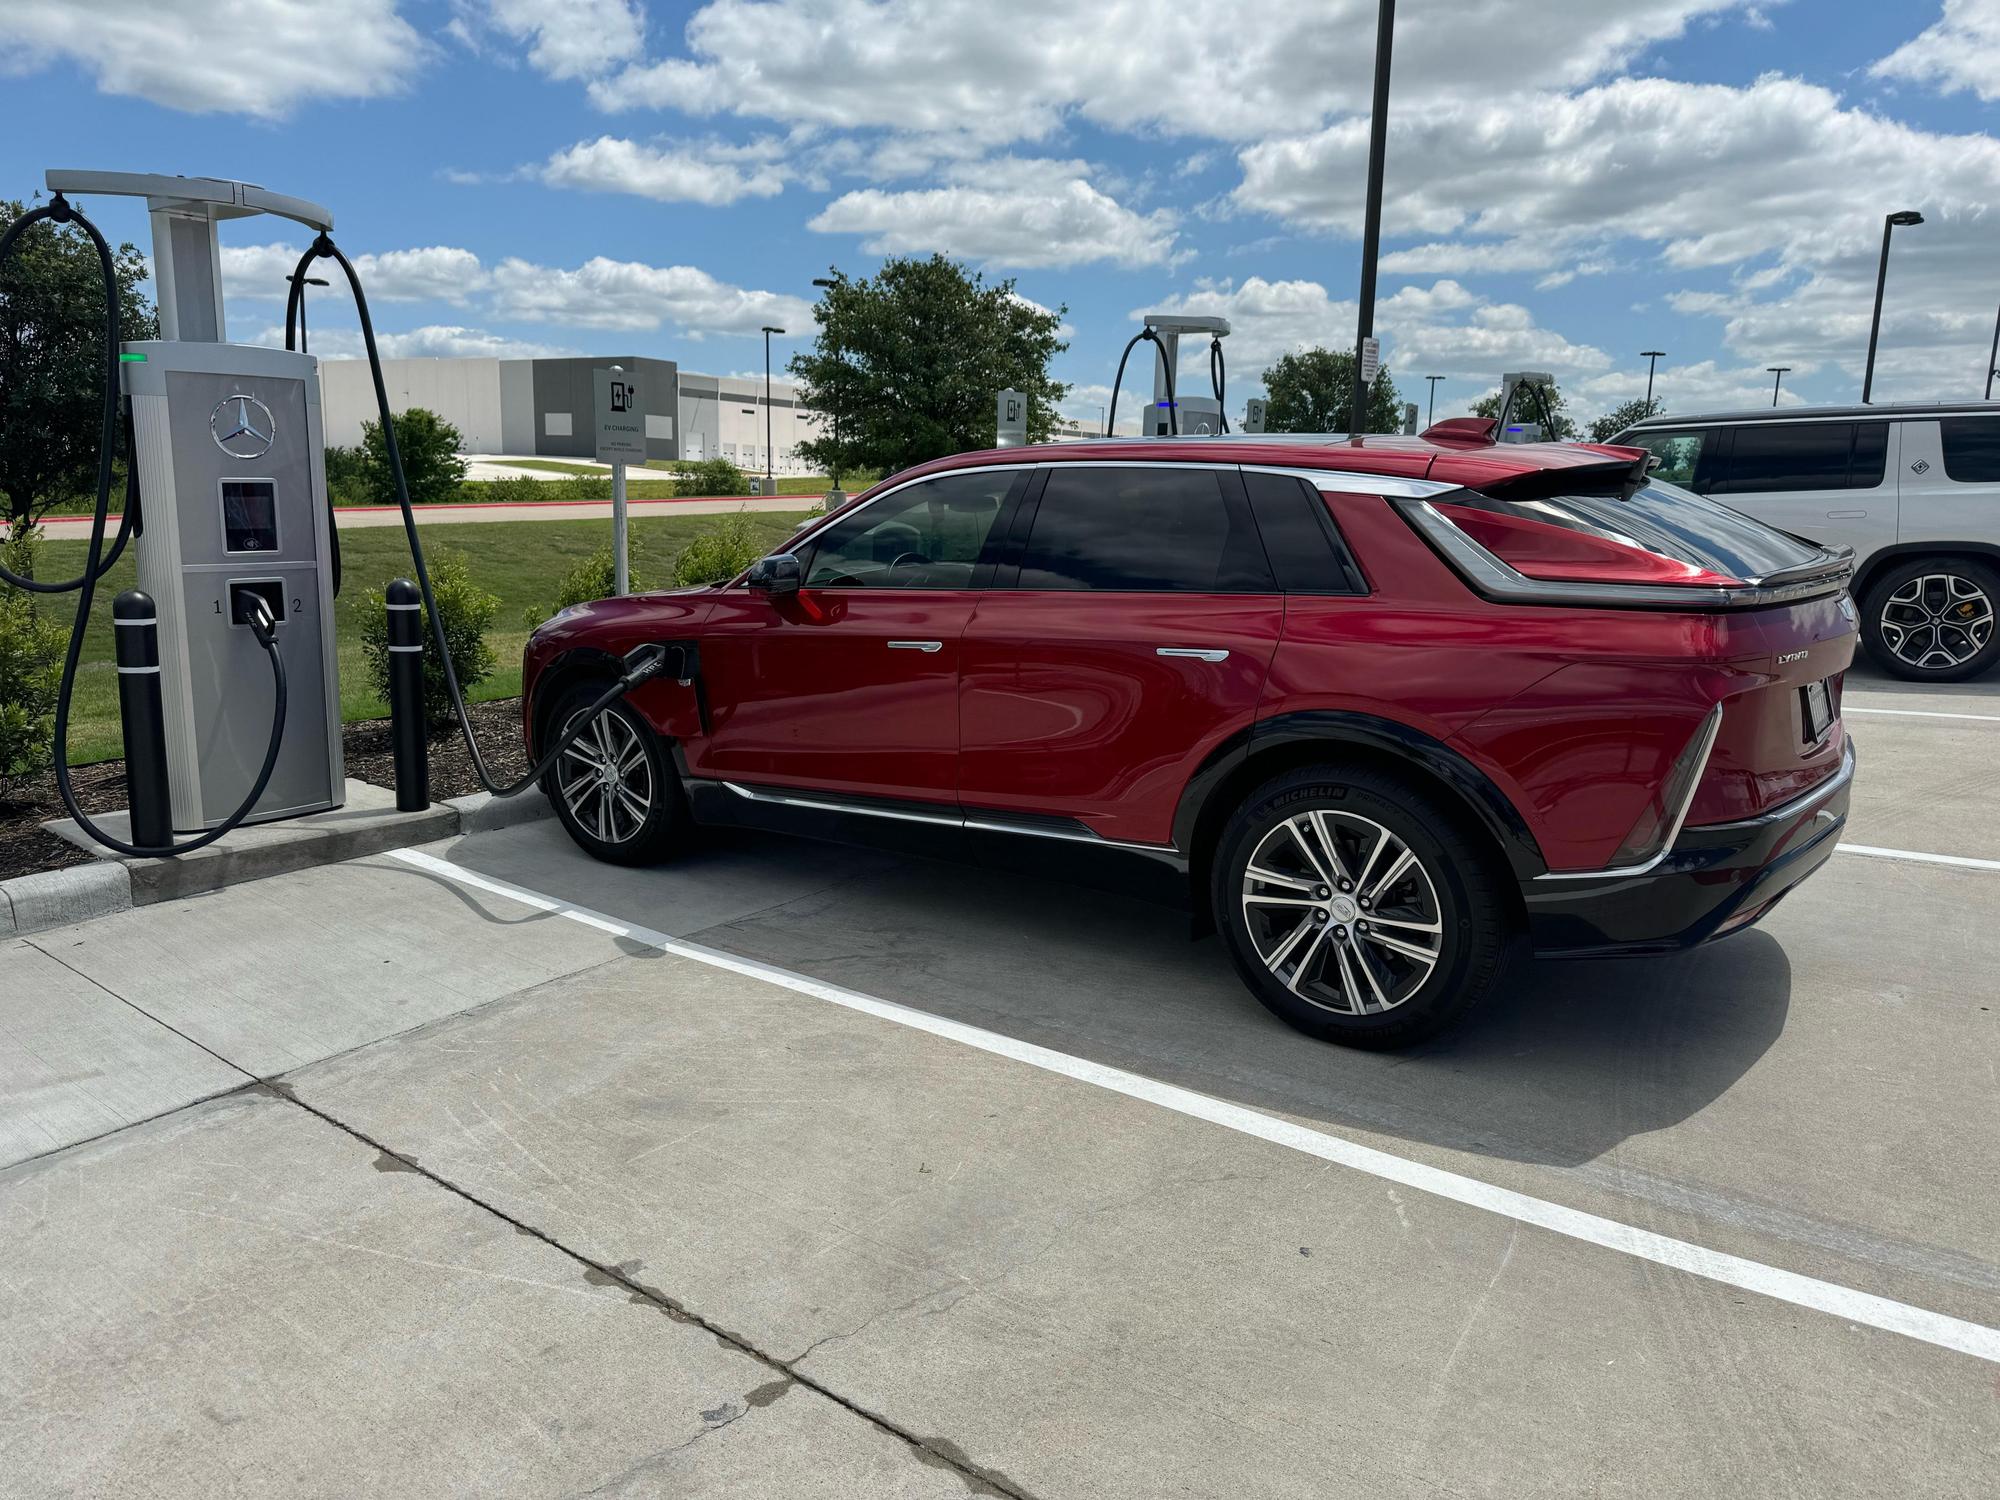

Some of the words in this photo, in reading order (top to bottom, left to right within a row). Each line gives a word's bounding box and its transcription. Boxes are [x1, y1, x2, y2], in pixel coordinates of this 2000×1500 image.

[214, 600, 222, 614] 1
[293, 598, 302, 613] 2
[643, 662, 662, 673] HPC
[1273, 787, 1345, 808] MICHELIN
